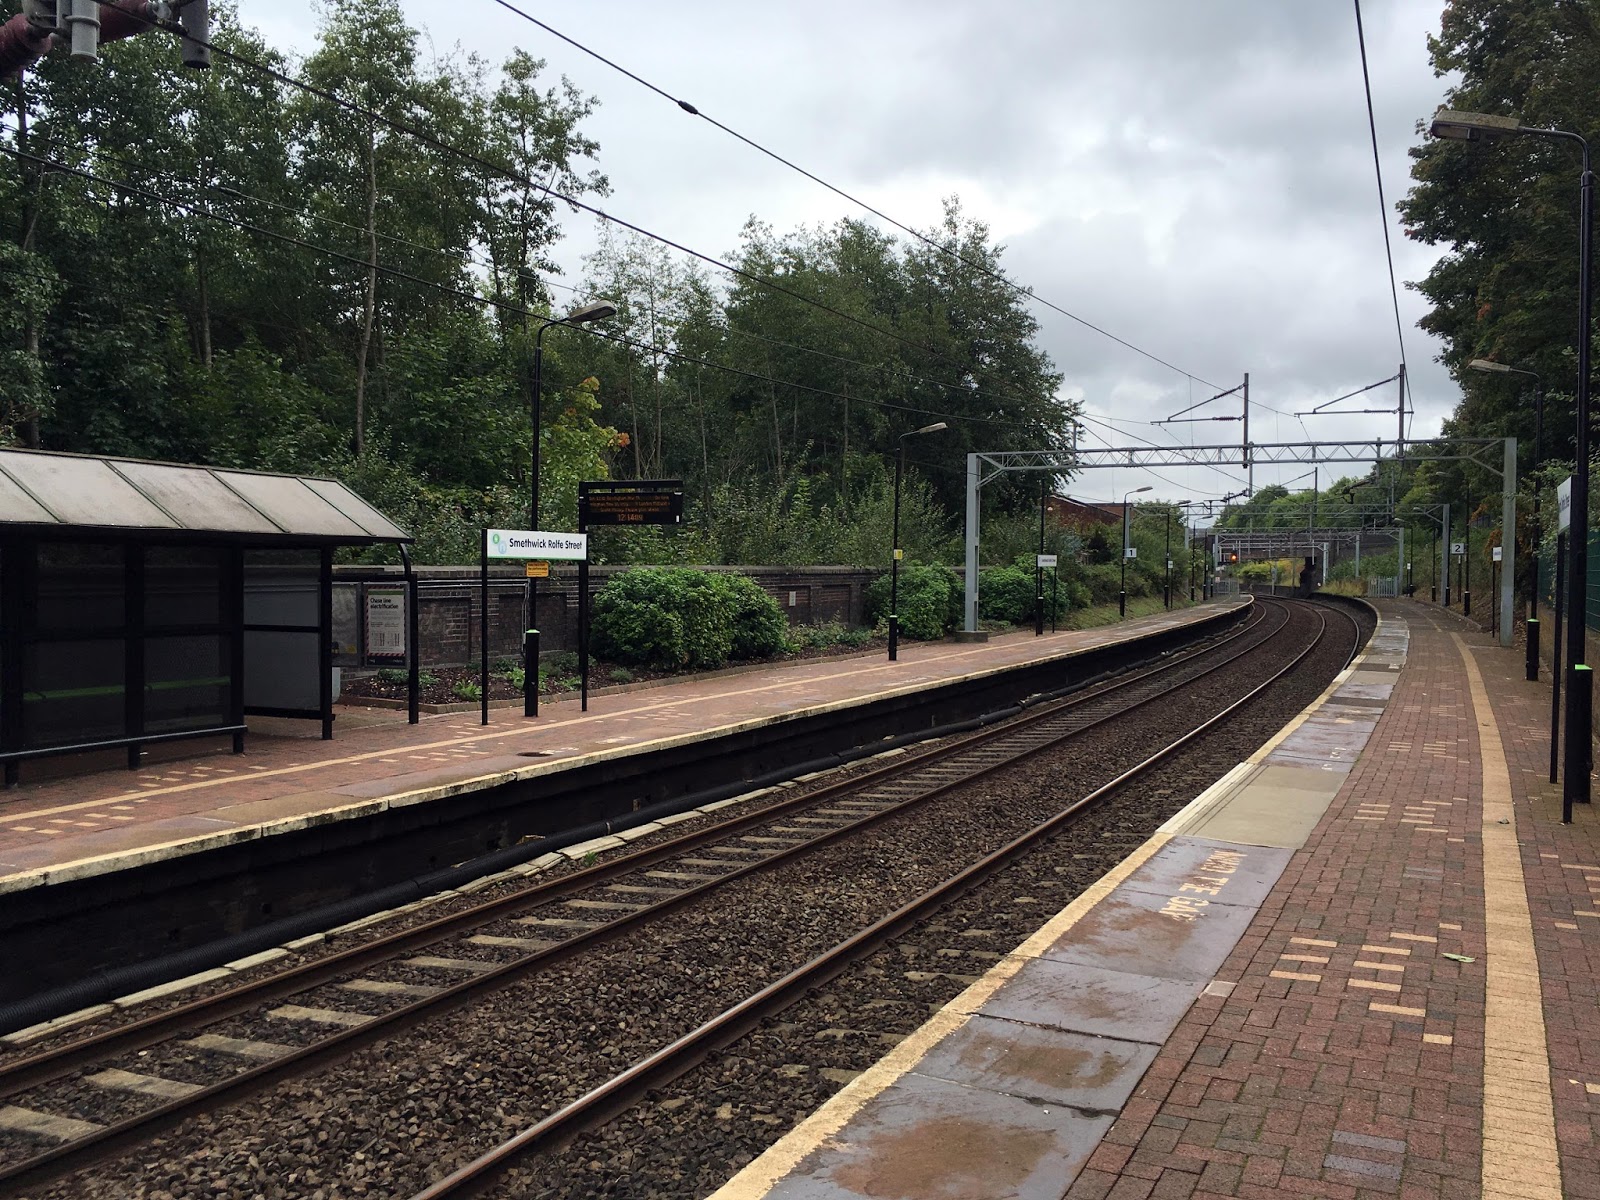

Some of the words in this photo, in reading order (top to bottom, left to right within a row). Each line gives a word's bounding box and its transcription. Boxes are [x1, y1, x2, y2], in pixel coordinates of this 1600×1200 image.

[509, 538, 547, 548] Smethwick
[548, 540, 564, 549] Rolfe
[565, 540, 582, 549] Street
[1455, 544, 1461, 552] 2
